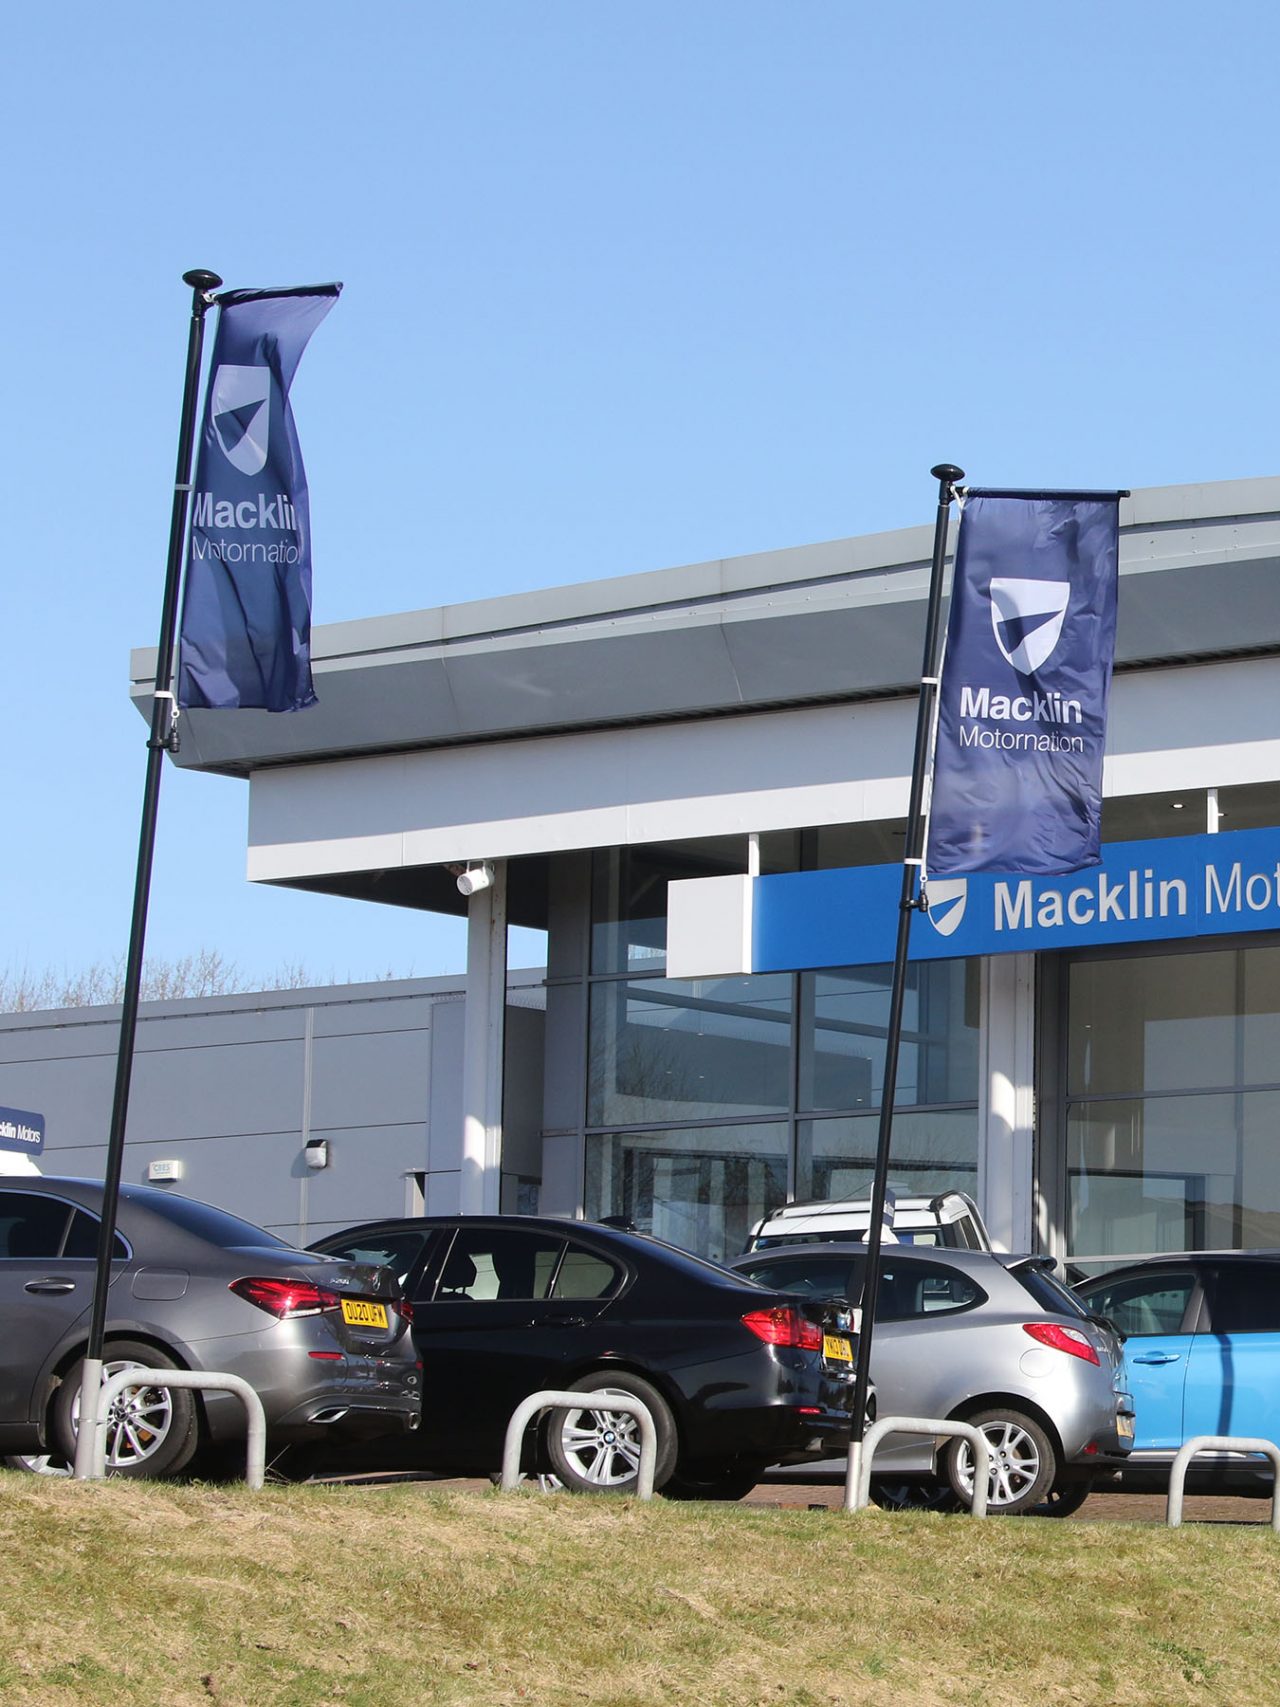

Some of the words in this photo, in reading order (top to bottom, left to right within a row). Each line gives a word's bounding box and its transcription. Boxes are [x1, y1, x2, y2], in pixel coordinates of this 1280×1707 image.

[192, 536, 300, 564] Motornatio
[960, 687, 1083, 723] Macklin
[959, 725, 1084, 753] Motornation
[994, 866, 1187, 931] Macklin
